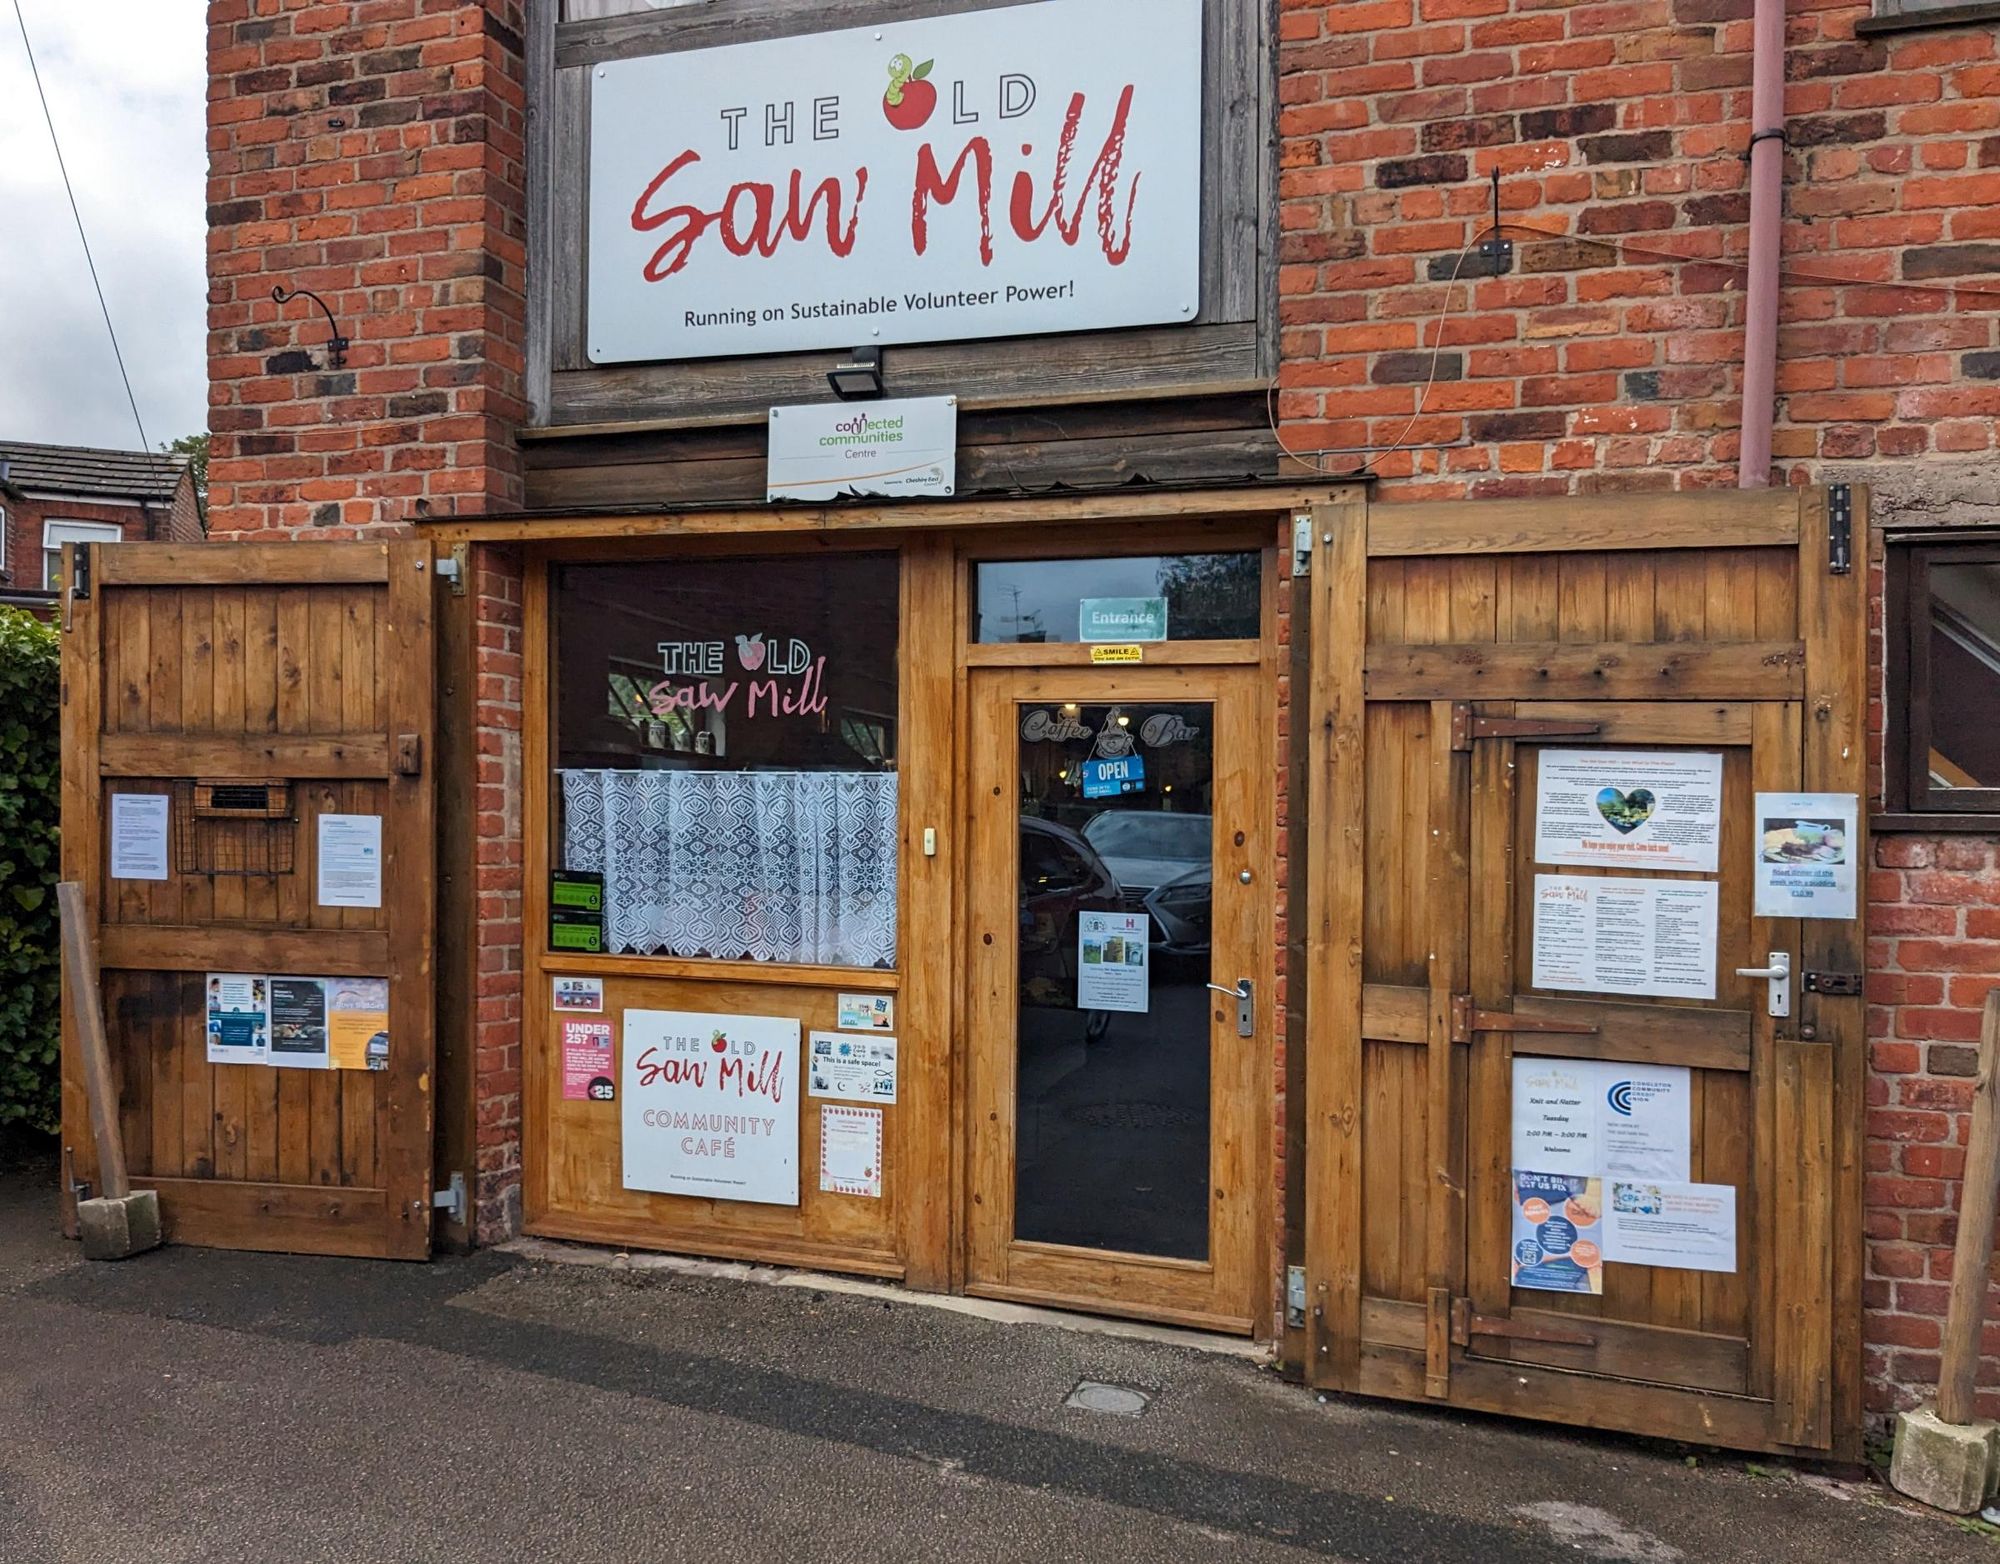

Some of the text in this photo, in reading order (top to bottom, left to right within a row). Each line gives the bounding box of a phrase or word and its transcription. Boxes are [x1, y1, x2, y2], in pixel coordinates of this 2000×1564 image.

[720, 95, 840, 151] THE
[631, 83, 1142, 284] Saw Mill
[684, 280, 1075, 328] Running on Sustainable Volunteer Power!
[835, 412, 904, 435] connected
[819, 430, 904, 446] communities
[844, 449, 877, 459] Centre
[1091, 611, 1154, 624] Entrance
[657, 641, 725, 675] THE
[747, 656, 829, 719] Mill
[1021, 710, 1199, 747] Coffee Bar
[1097, 760, 1129, 781] OPEN
[566, 1023, 610, 1035] UNDER
[566, 1034, 588, 1044] 25?
[663, 1036, 700, 1052] THE
[636, 1047, 708, 1088] Saw
[719, 1050, 785, 1103] Mill
[861, 1060, 881, 1068] space!
[595, 1085, 614, 1099] 25
[643, 1108, 775, 1136] COMMUNITY
[681, 1137, 736, 1159] CAFÉ
